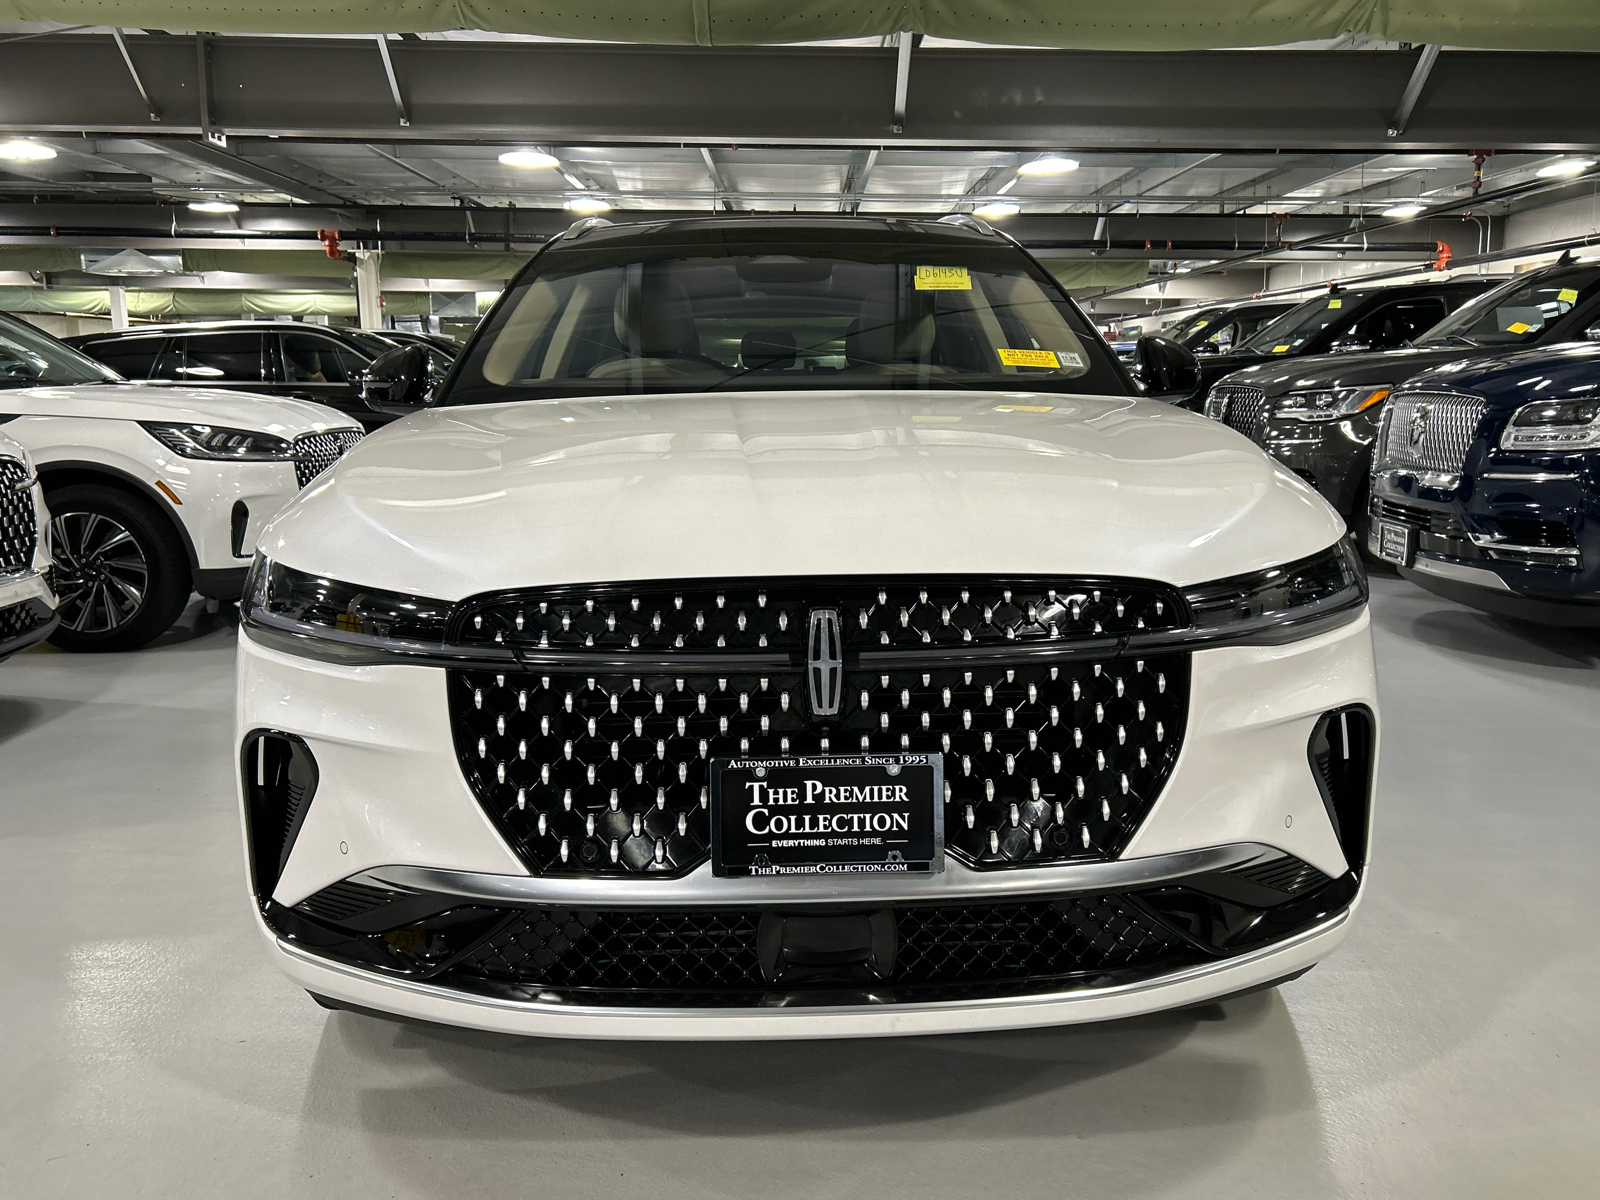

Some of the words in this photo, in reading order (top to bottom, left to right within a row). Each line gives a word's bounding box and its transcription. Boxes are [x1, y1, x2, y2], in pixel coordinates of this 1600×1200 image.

[728, 758, 796, 769] AUTOMOTIVE
[798, 757, 862, 767] EXCELLENCE
[864, 755, 896, 765] SINCE
[898, 755, 927, 764] 1995
[745, 780, 799, 806] THE
[803, 780, 910, 804] PREMIER
[745, 808, 910, 835] COLLECTION
[771, 839, 826, 848] EVERYTHING
[827, 838, 859, 846] STARTS
[860, 837, 884, 845] HERE.
